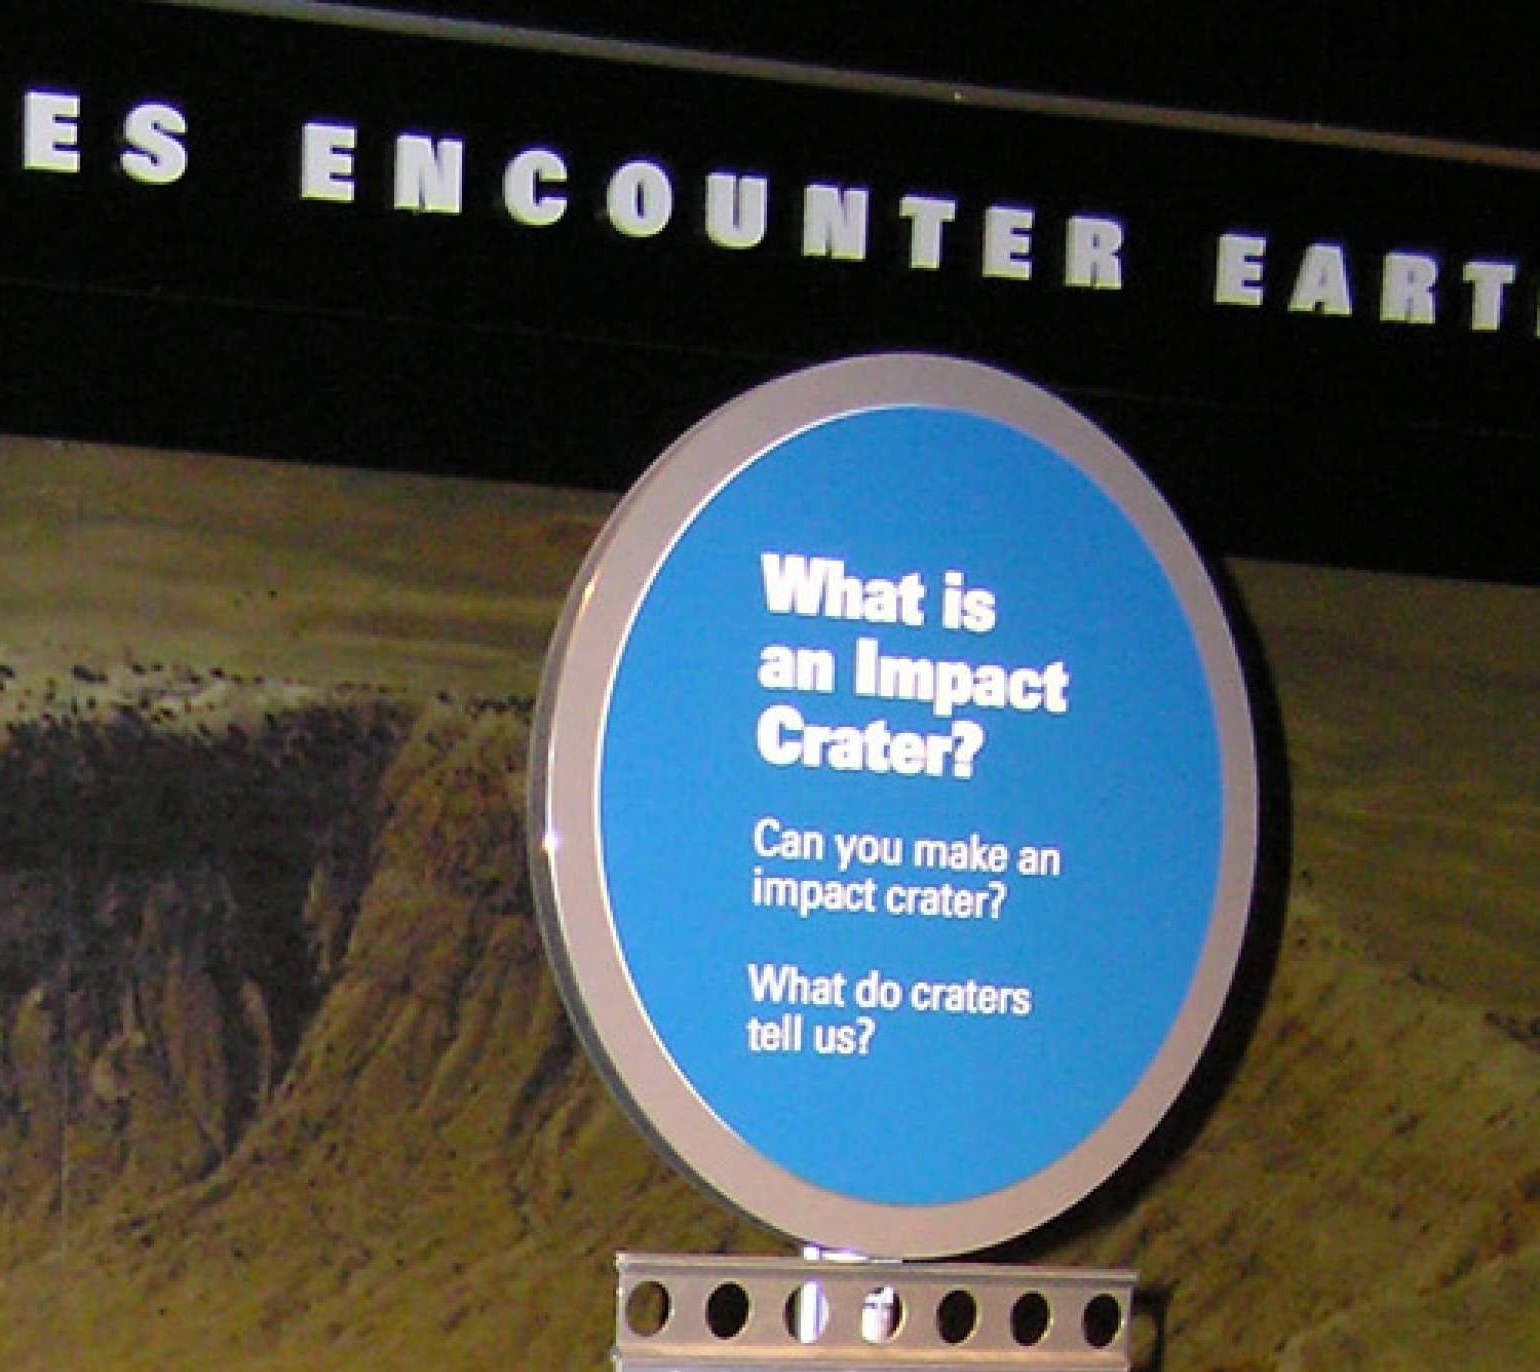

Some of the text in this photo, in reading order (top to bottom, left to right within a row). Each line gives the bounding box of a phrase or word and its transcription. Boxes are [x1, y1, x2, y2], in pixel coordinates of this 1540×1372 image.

[301, 122, 1123, 290] ENCOUNTER
[1216, 233, 1540, 337] EART
[760, 553, 997, 633] What is
[758, 637, 1071, 718] an Impact
[757, 704, 984, 779] Crater?
[753, 819, 1061, 877] Can you make an
[753, 869, 1008, 920] impact crater?
[747, 964, 1032, 1017] What do craters
[747, 1015, 877, 1056] tell us?
